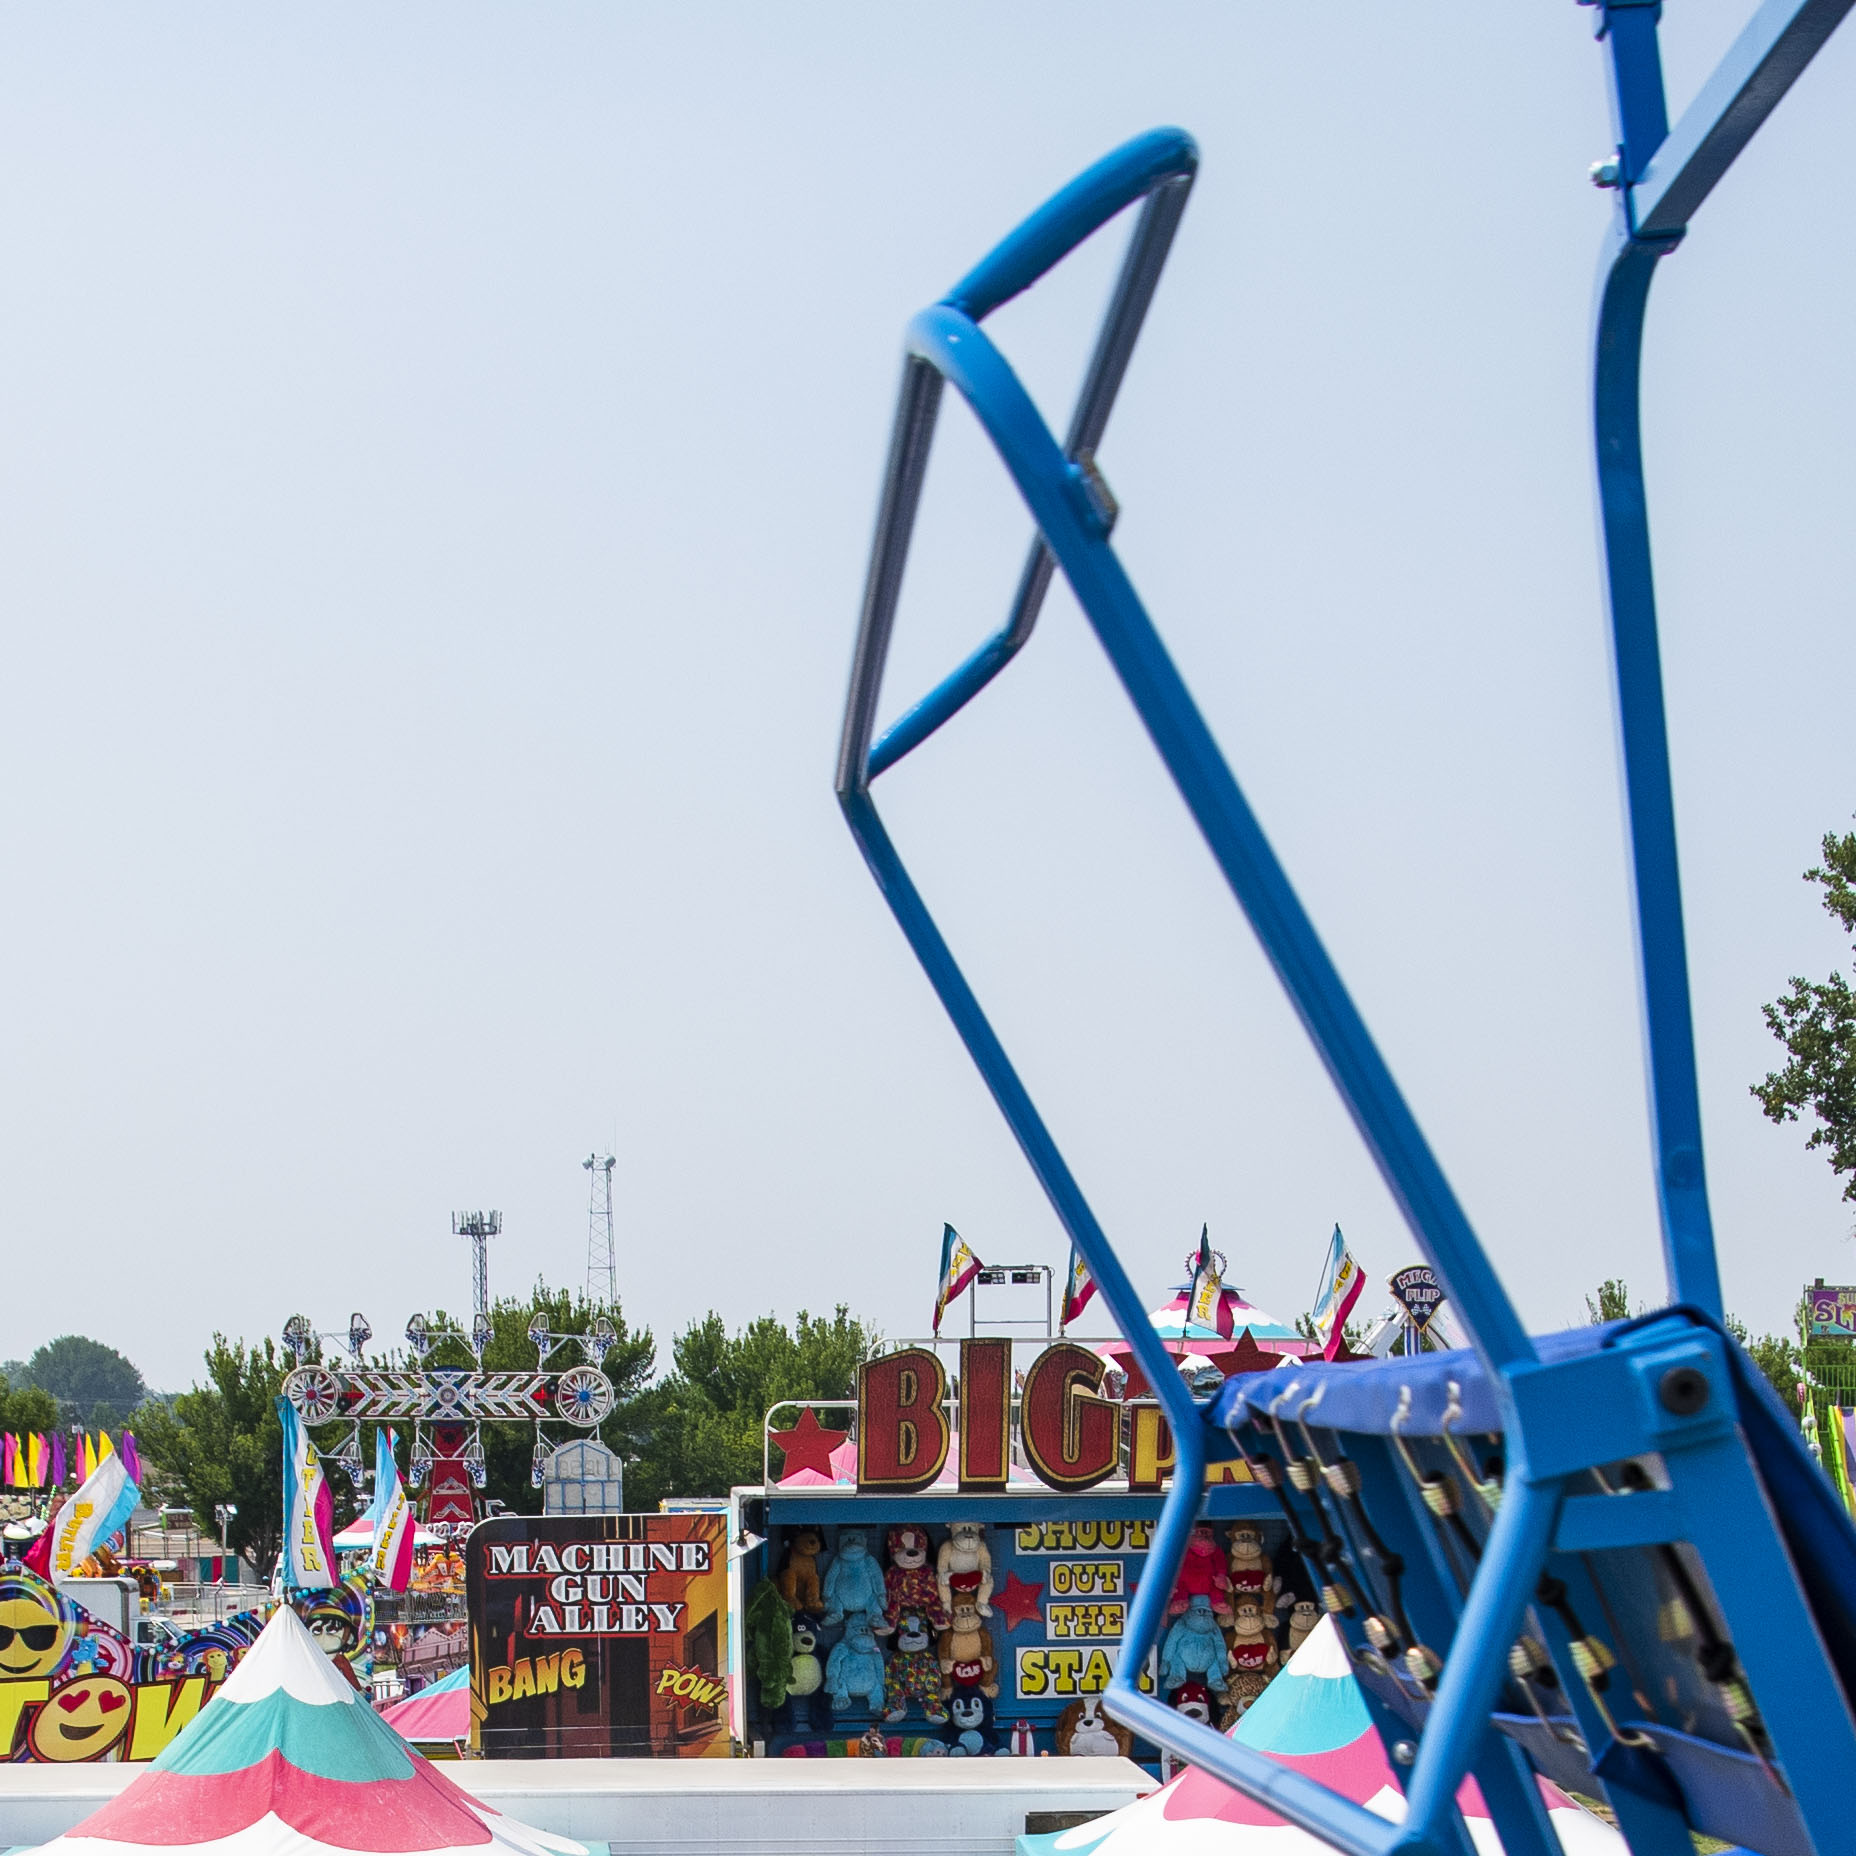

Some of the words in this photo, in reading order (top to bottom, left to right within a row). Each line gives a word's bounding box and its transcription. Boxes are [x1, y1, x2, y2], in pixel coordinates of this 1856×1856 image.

[1405, 1287, 1441, 1303] FLIP
[857, 1337, 1122, 1493] BIG
[55, 1502, 94, 1572] BUTLER
[488, 1543, 710, 1574] MACHINE
[550, 1574, 649, 1604] GUN
[1052, 1563, 1120, 1594] OUT
[529, 1603, 685, 1634] ALLEY
[1050, 1603, 1124, 1637] THE
[488, 1647, 587, 1705] BANG
[656, 1669, 729, 1706] POW!
